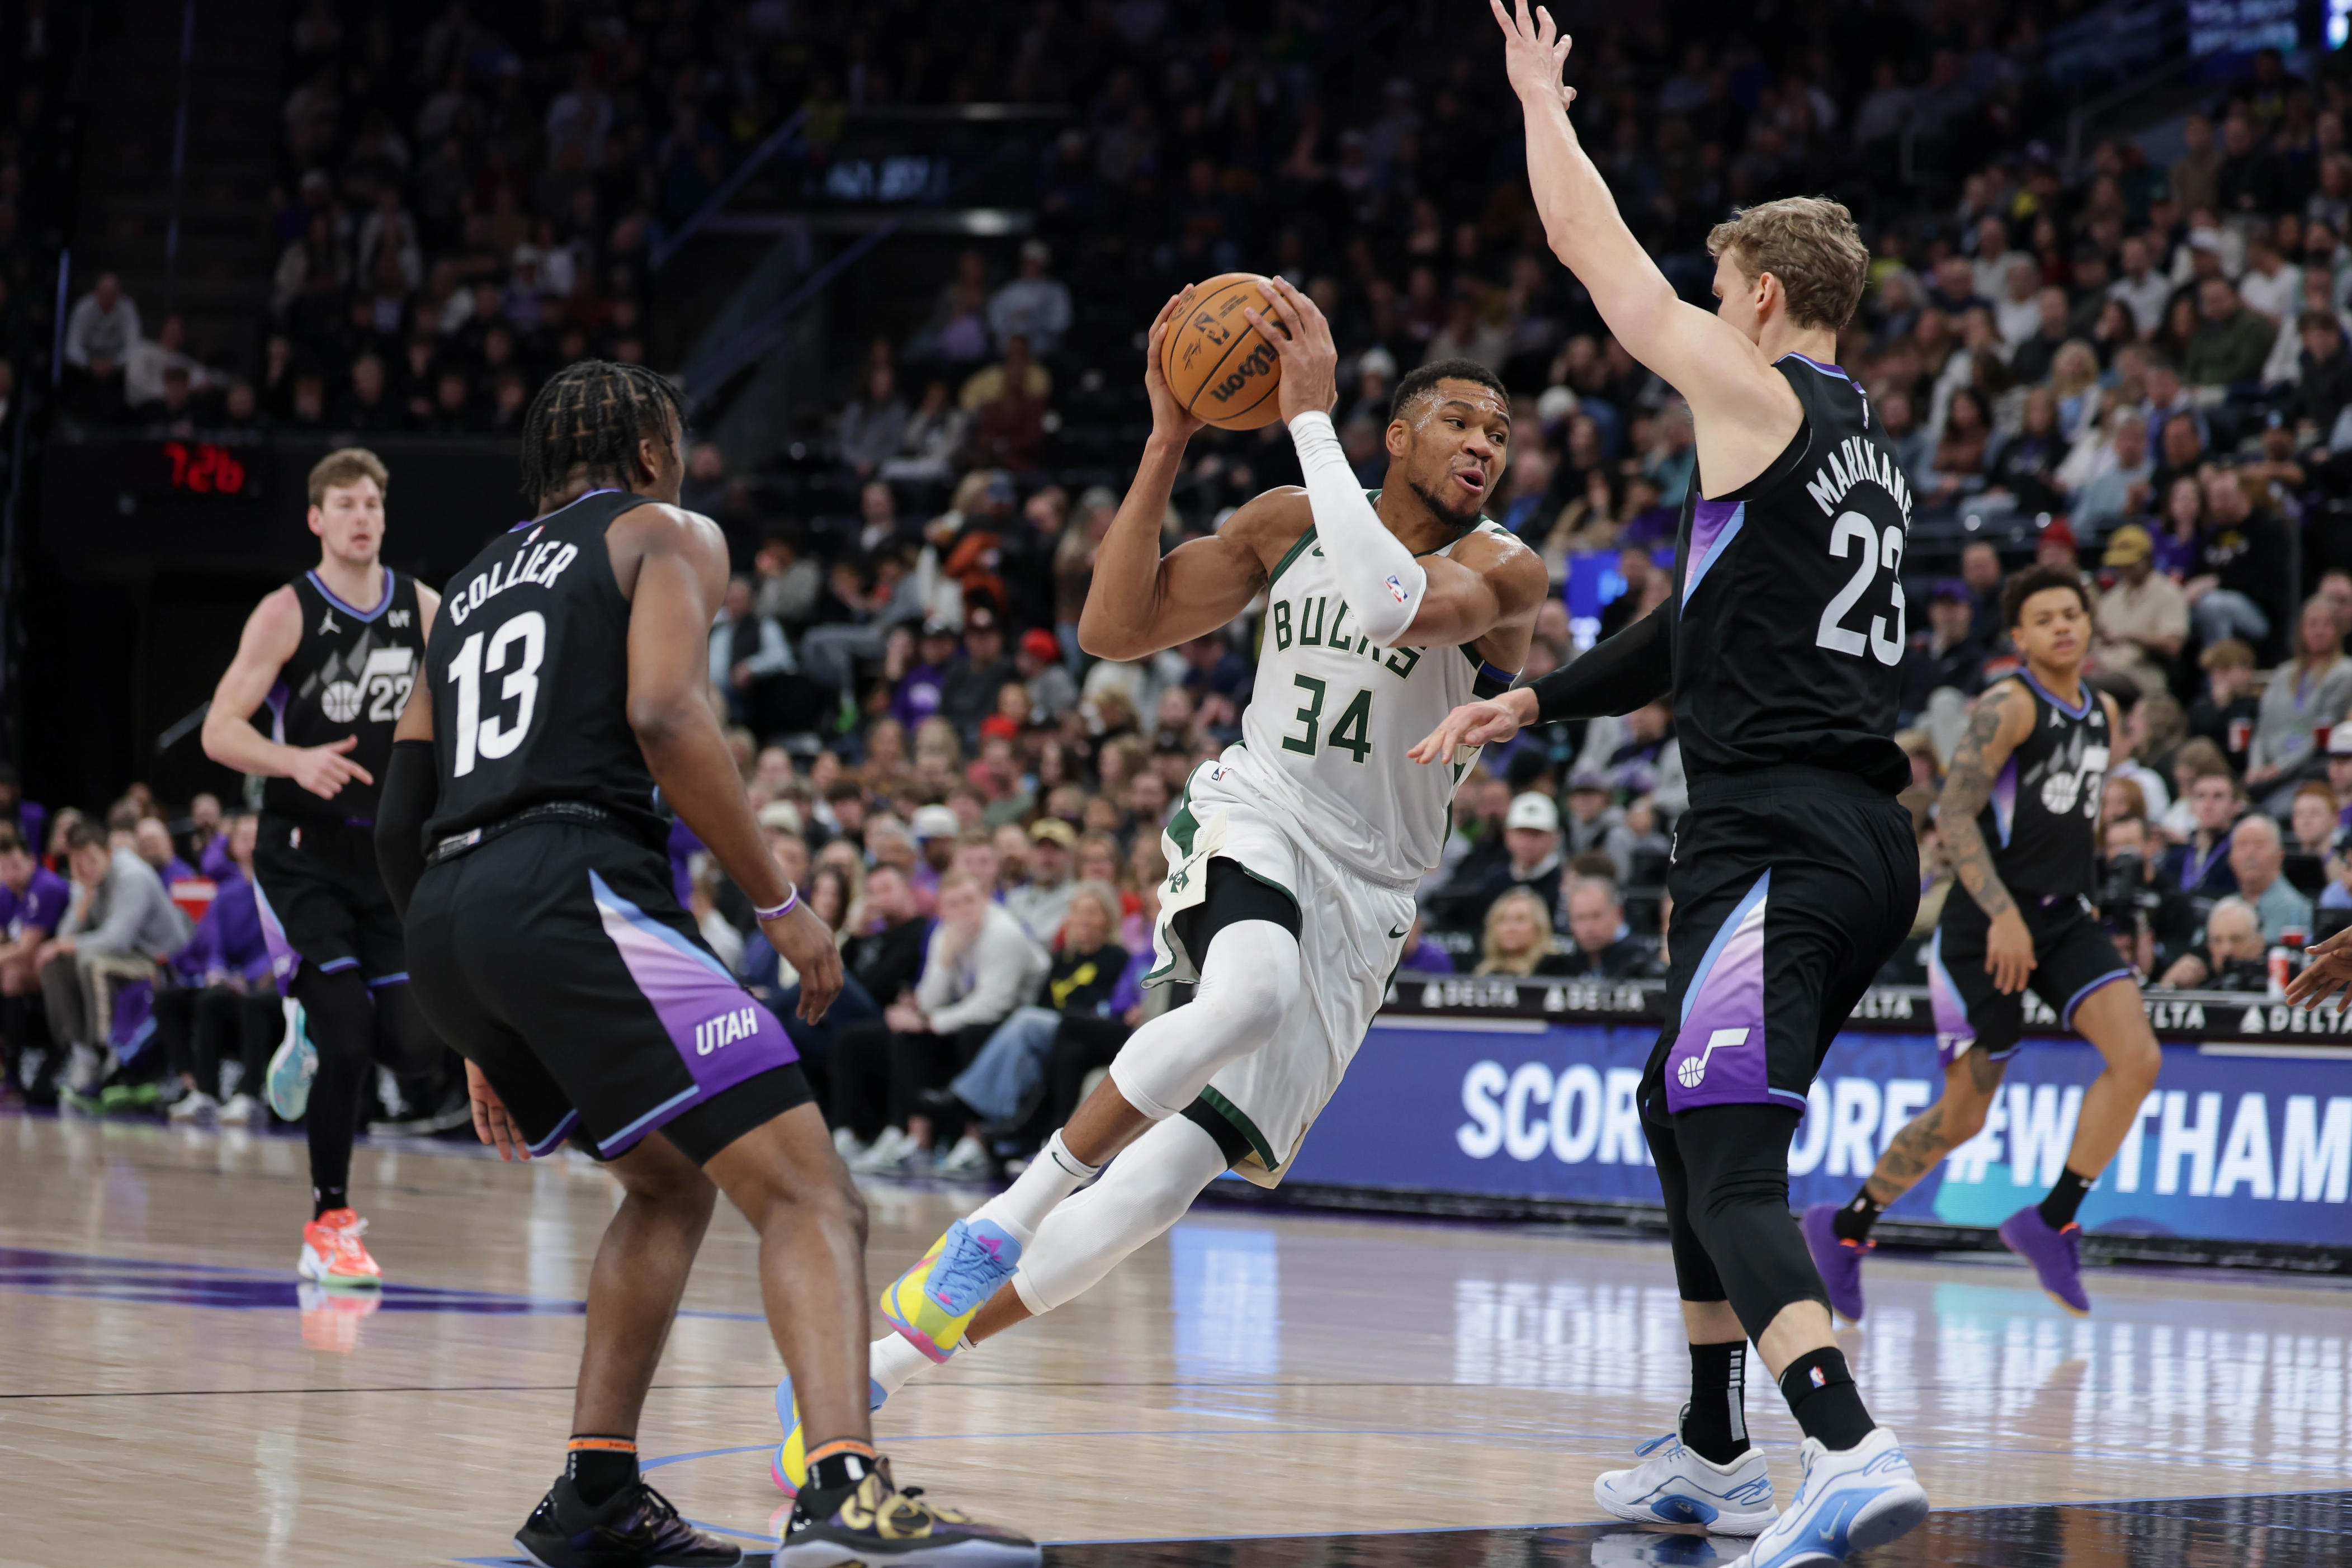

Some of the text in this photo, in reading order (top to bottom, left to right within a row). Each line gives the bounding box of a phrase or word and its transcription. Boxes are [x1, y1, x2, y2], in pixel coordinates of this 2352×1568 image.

[450, 540, 578, 626] COLLIER
[1816, 511, 1905, 666] 23
[369, 675, 413, 722] 22
[448, 611, 546, 777] 13
[1279, 670, 1375, 768] 34
[696, 1006, 759, 1056] UTAH
[1456, 1060, 1656, 1167] SCOR
